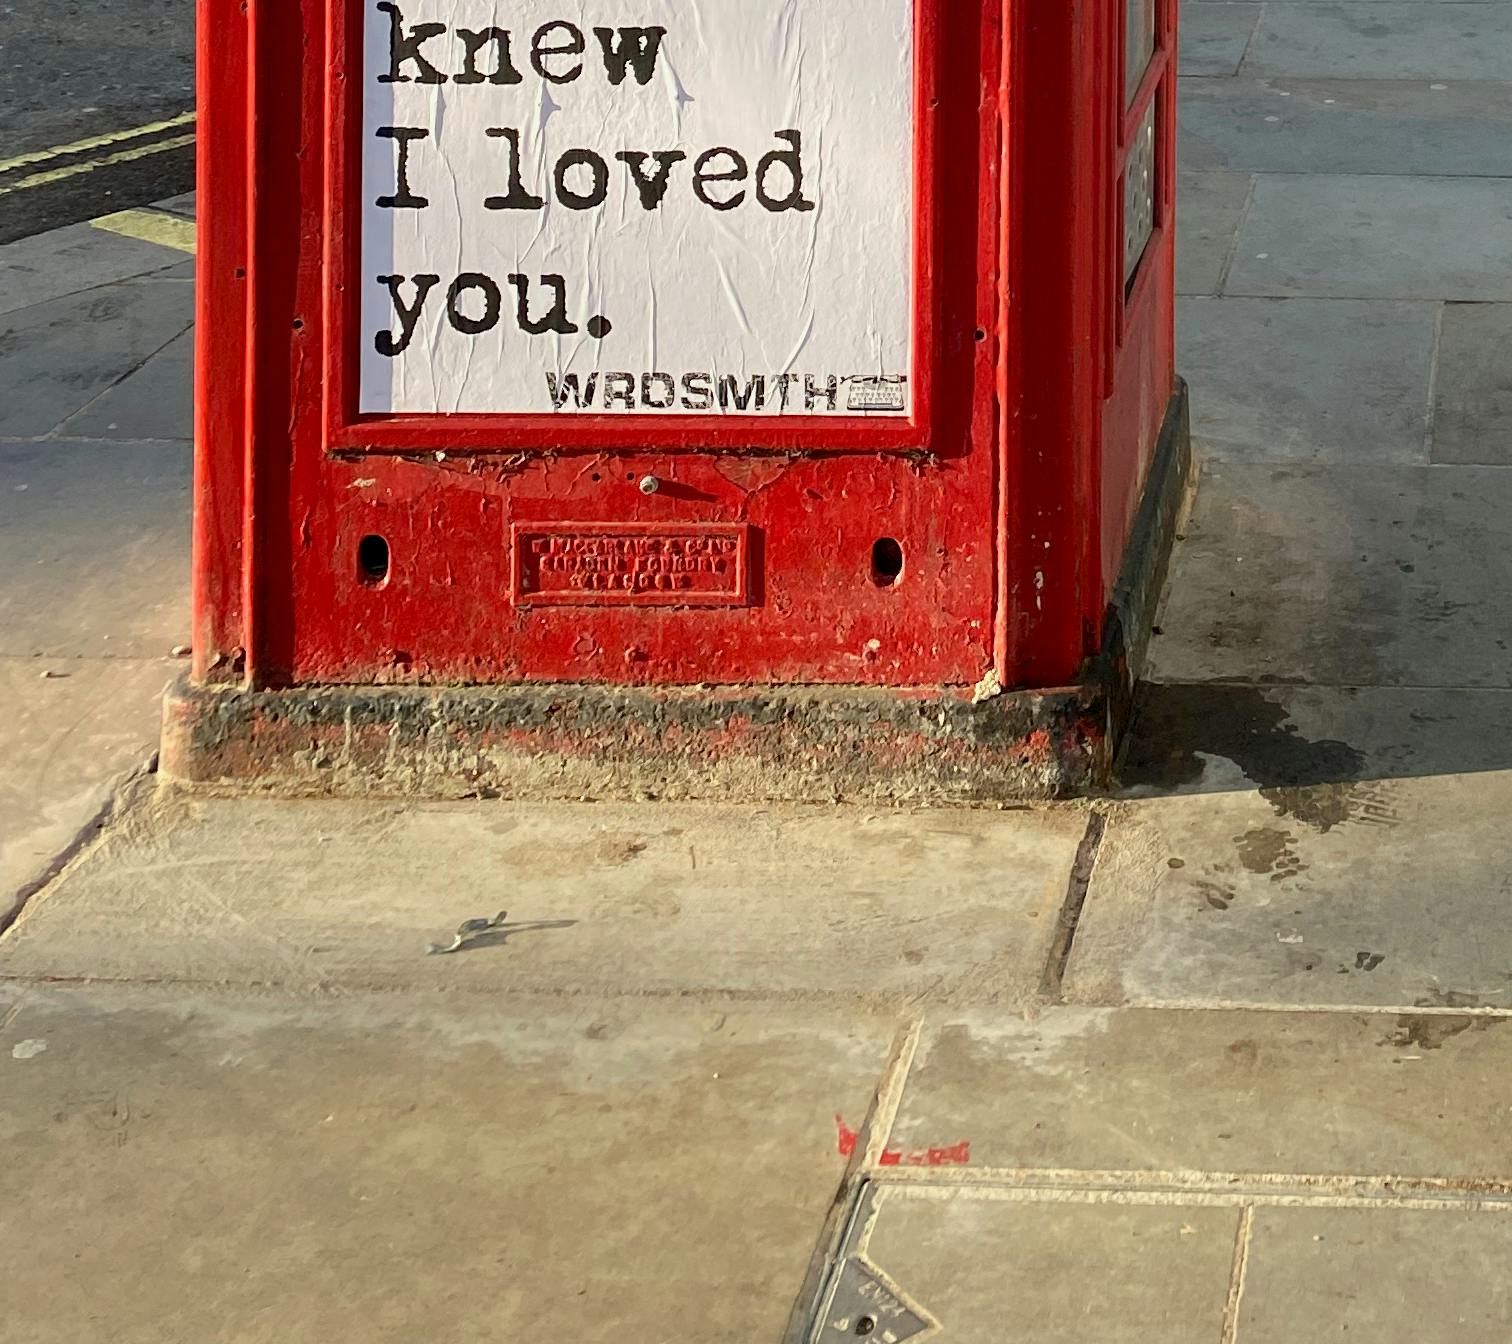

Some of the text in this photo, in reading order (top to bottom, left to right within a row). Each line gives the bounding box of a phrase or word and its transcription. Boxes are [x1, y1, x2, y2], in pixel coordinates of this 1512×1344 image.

[375, 0, 668, 87] knew
[374, 125, 816, 213] I loved
[373, 271, 613, 359] you.
[545, 370, 838, 411] WRDSMTH
